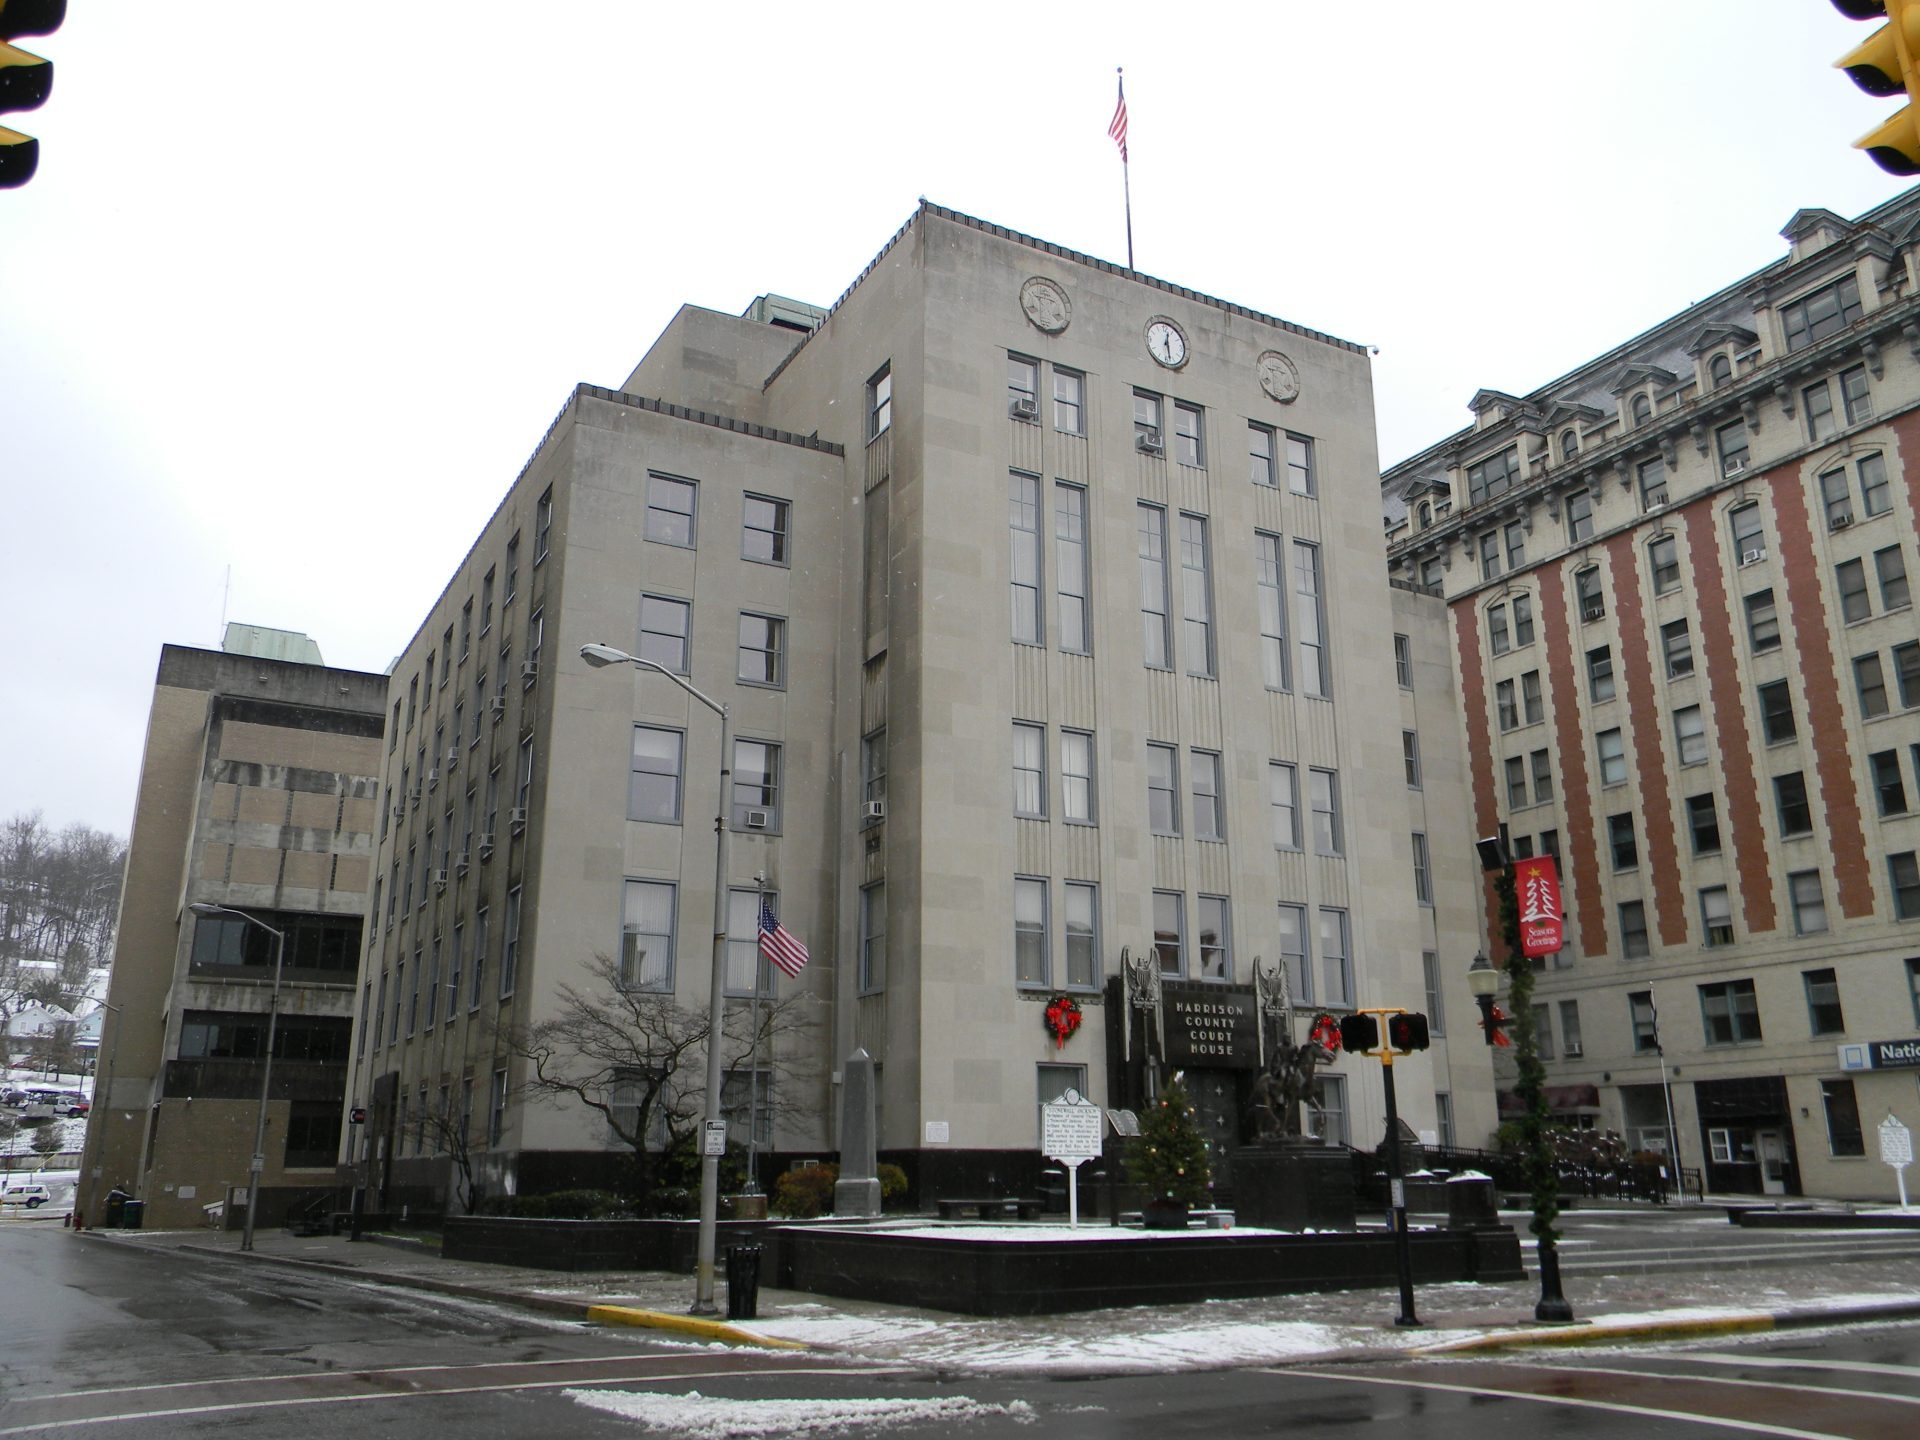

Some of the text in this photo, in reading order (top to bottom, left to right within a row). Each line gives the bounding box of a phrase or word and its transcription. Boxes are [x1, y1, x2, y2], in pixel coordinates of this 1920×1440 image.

[1528, 927, 1556, 937] Seasons
[1526, 937, 1558, 947] Greetings
[1176, 1002, 1243, 1015] HARRISON
[1185, 1017, 1235, 1028] COUNTY
[1190, 1031, 1232, 1042] COURT
[1190, 1043, 1233, 1055] HOUSE
